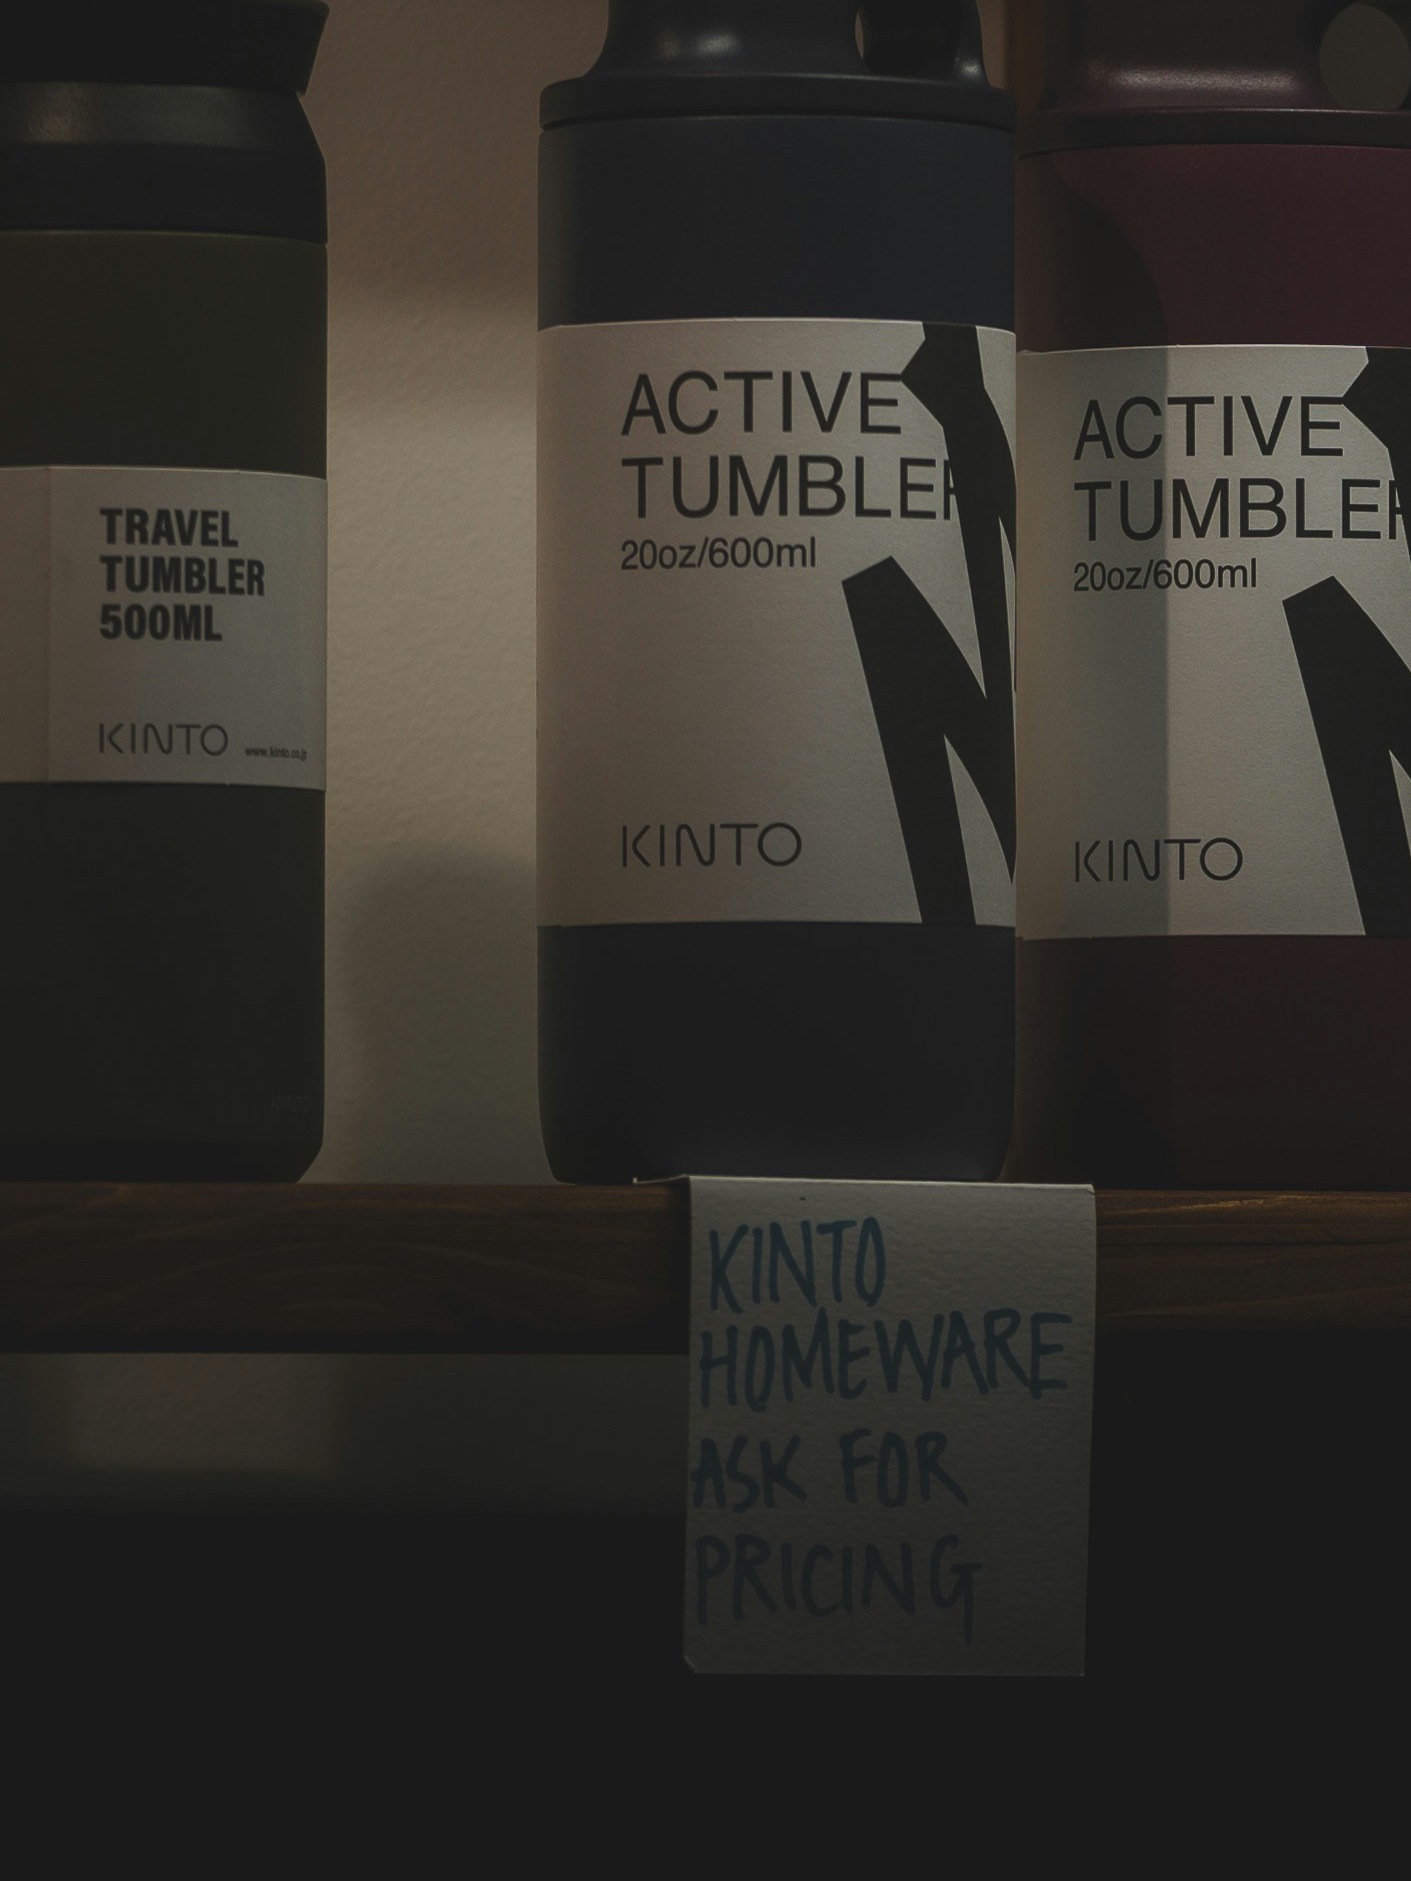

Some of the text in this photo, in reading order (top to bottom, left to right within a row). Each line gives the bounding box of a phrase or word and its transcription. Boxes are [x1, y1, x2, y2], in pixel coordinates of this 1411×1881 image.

[621, 371, 902, 436] ACTIVE
[1074, 396, 1344, 460] ACTIVE
[100, 508, 238, 547] TRAVEL
[621, 537, 815, 570] 20oz/600ml
[1074, 558, 1257, 591] 20oz/600ml
[99, 556, 265, 596] TUMBLER
[100, 605, 222, 642] 500ML
[99, 723, 228, 756] KINTO
[621, 823, 802, 867] KINTO
[1074, 837, 1243, 882] KINTO
[709, 1217, 887, 1313] KINTO
[699, 1308, 1073, 1412] HOMEWARE
[691, 1428, 969, 1513] ASK FOR
[694, 1533, 983, 1645] PRICING
